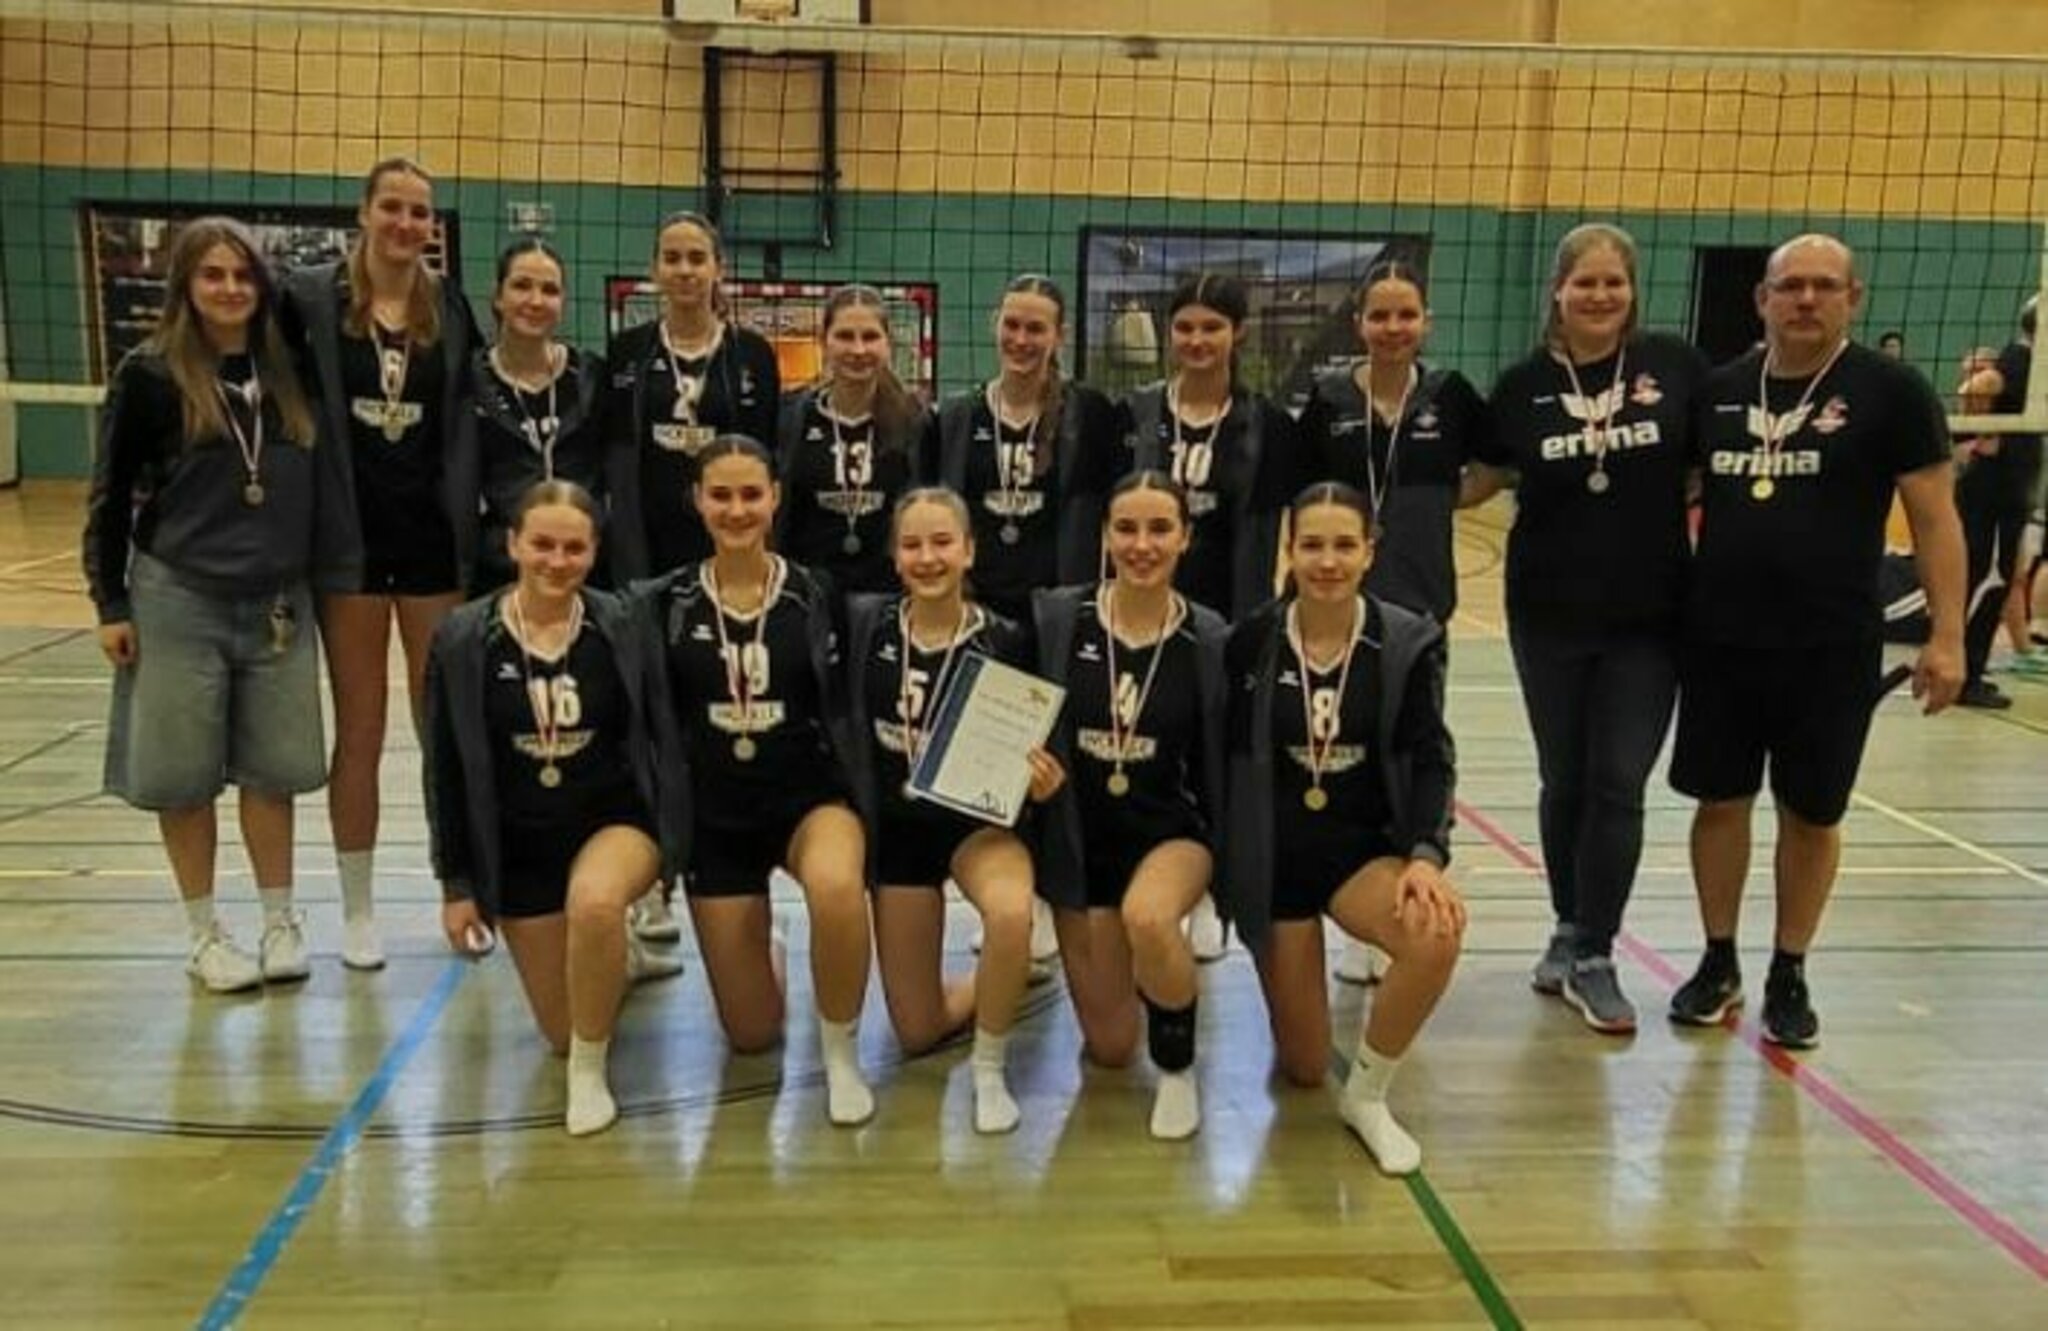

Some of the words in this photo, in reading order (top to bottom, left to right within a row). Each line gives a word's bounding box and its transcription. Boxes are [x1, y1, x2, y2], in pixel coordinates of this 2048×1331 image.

[672, 375, 702, 420] 2
[829, 441, 872, 487] 13
[1169, 440, 1213, 487] 10
[1541, 420, 1660, 461] erima
[1711, 446, 1821, 477] erima
[719, 641, 770, 696] 19
[527, 674, 582, 728] 16
[897, 667, 930, 720] 5
[1312, 687, 1340, 741] 8
